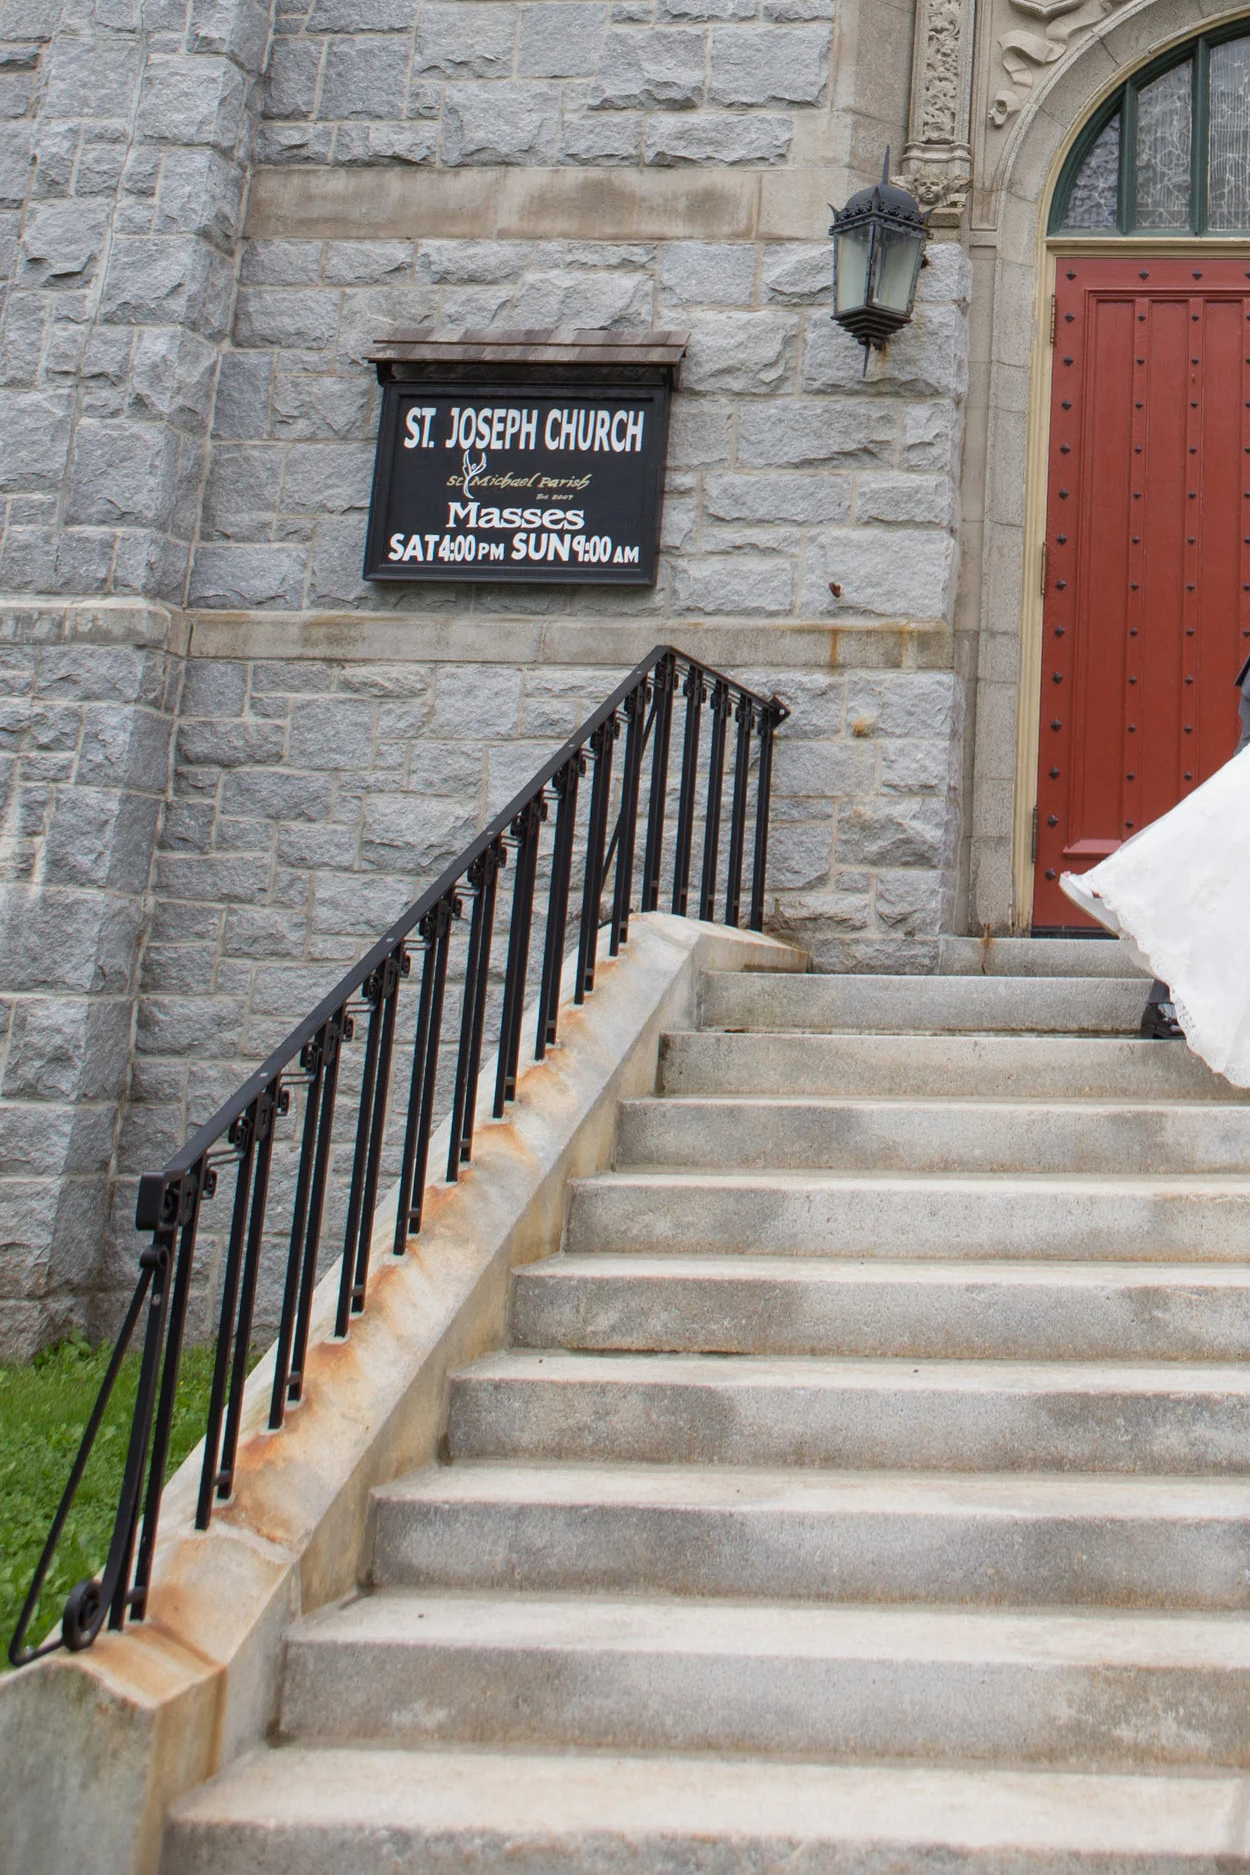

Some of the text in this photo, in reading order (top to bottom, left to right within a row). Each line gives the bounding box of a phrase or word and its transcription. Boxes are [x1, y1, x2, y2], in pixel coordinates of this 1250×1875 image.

[403, 407, 645, 452] ST. JOSEPH CHURCH
[469, 472, 541, 489] Michael
[537, 473, 592, 490] Parish
[445, 501, 585, 531] Masses
[388, 532, 639, 564] SAT 4:00 PM SUN 9:00 AM
